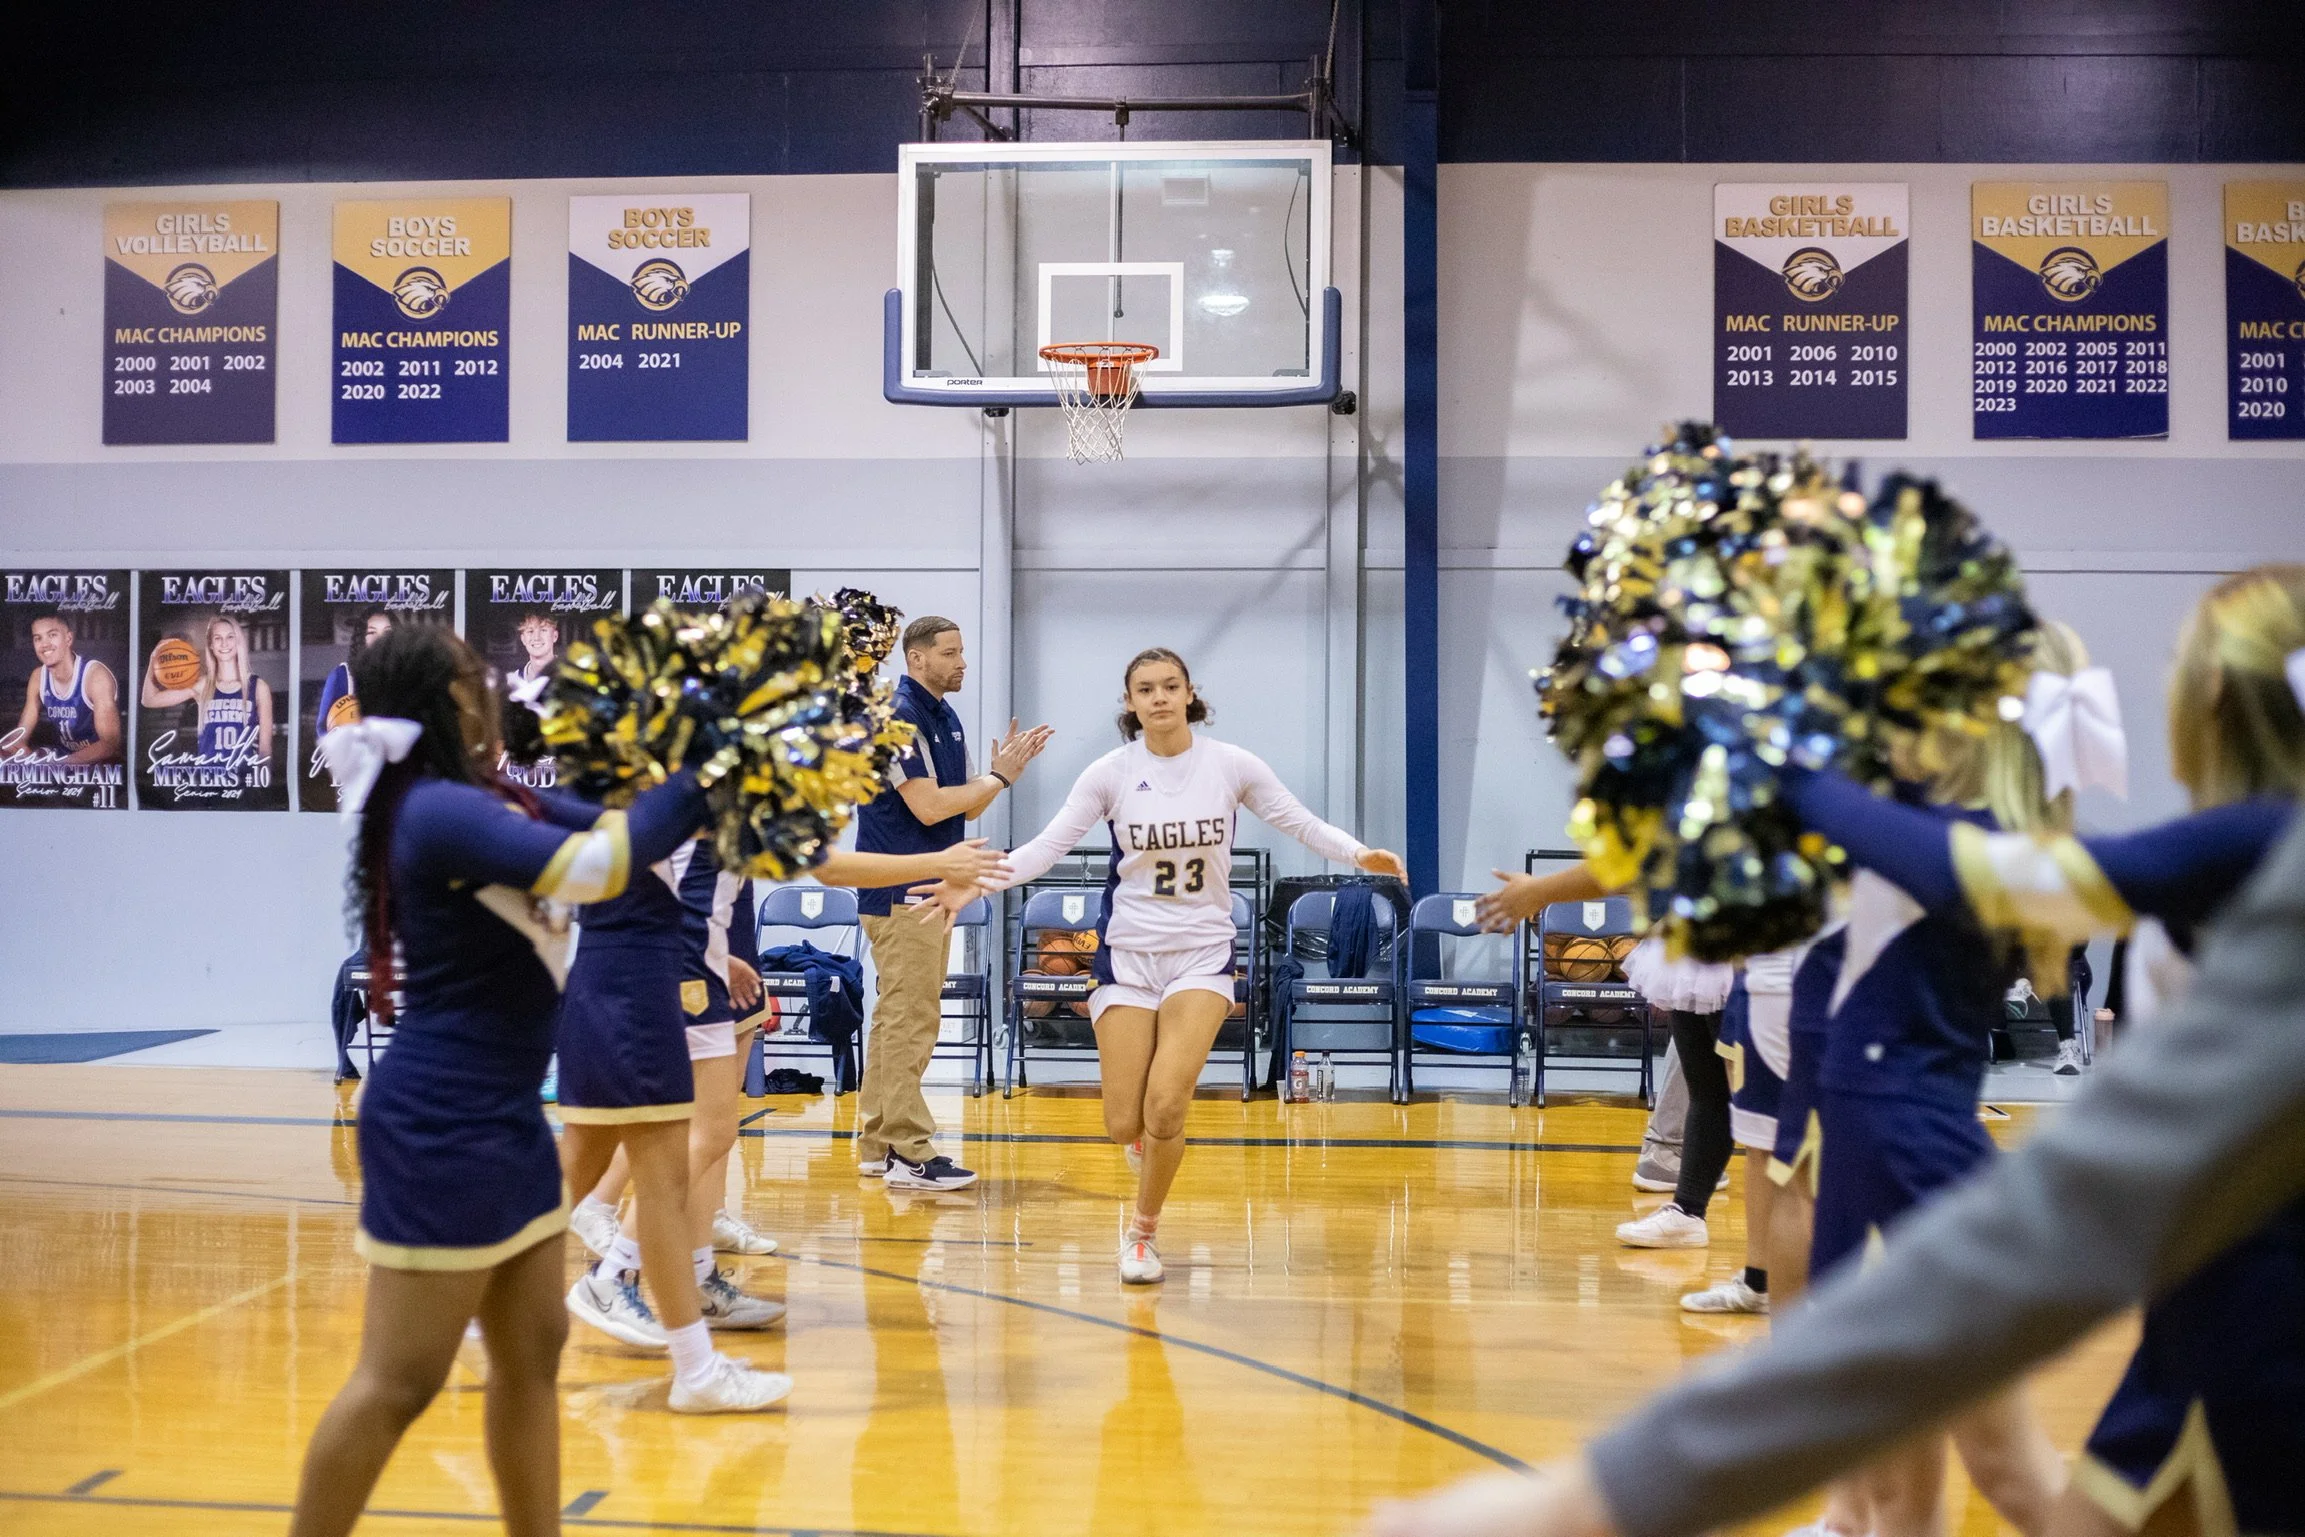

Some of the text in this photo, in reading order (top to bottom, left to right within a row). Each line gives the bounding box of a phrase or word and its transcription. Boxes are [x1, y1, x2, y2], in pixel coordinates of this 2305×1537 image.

[1770, 195, 1854, 216] GIRLS
[2027, 194, 2113, 216] GIRLS
[155, 213, 230, 235] GIRLS
[623, 207, 695, 228] BOYS
[1981, 216, 2157, 237] BASKETBALL
[387, 216, 456, 238] BOYS
[1725, 216, 1899, 238] BASKETBALL
[115, 234, 268, 255] VOLLEYBALL
[370, 237, 472, 257] SOCCER
[608, 228, 711, 249] SOCCER
[578, 322, 741, 341] MAC RUNNER-UP
[1726, 315, 1899, 332] MAC RUNNER-UP
[1984, 314, 2157, 332] MAC CHAMPIONS
[2240, 322, 2305, 338] MAC C
[115, 326, 267, 344] MAC CHAMPIONS
[341, 331, 499, 348] MAC CHAMPIONS
[1727, 346, 1898, 361] 2001 2006 2010
[1975, 342, 2167, 356] 2000 2002 2005 2011
[114, 355, 266, 371] 2000 2001 2002
[341, 360, 498, 377] 2002 2011 2012
[579, 353, 681, 370] 2004 2021
[1975, 361, 2167, 375] 2012 2016 2017 2018
[2240, 353, 2285, 368] 2001
[114, 379, 211, 395] 2003 2004
[1727, 370, 1898, 386] 2013 2014 2015
[1975, 379, 2167, 393] 2019 2020 2021 2022
[2241, 378, 2288, 393] 2010
[341, 384, 441, 400] 2020 2022
[1975, 398, 2017, 412] 2023
[2238, 402, 2286, 417] 2020
[5, 575, 107, 603] EAGLES
[161, 576, 266, 604] EAGLES
[324, 574, 430, 602] EAGLES
[489, 574, 598, 603] EAGLES
[656, 574, 765, 603] EAGLES
[214, 726, 238, 750] 10
[147, 725, 271, 773] Samantha
[153, 765, 271, 788] MEYERS #10
[16, 780, 59, 797] Senior
[93, 785, 116, 808] #11
[174, 782, 218, 801] Senior
[1129, 818, 1224, 851] EAGLES
[1154, 857, 1205, 896] 23
[783, 979, 806, 987] ACADE
[1023, 982, 1087, 991] CONCORD ACADE
[1306, 985, 1379, 994] CONCORD ACADEMY
[1424, 987, 1498, 997] CONCORD ACADEMY
[1562, 989, 1636, 999] CONCORD ACADEMY
[1294, 1077, 1304, 1090] G
